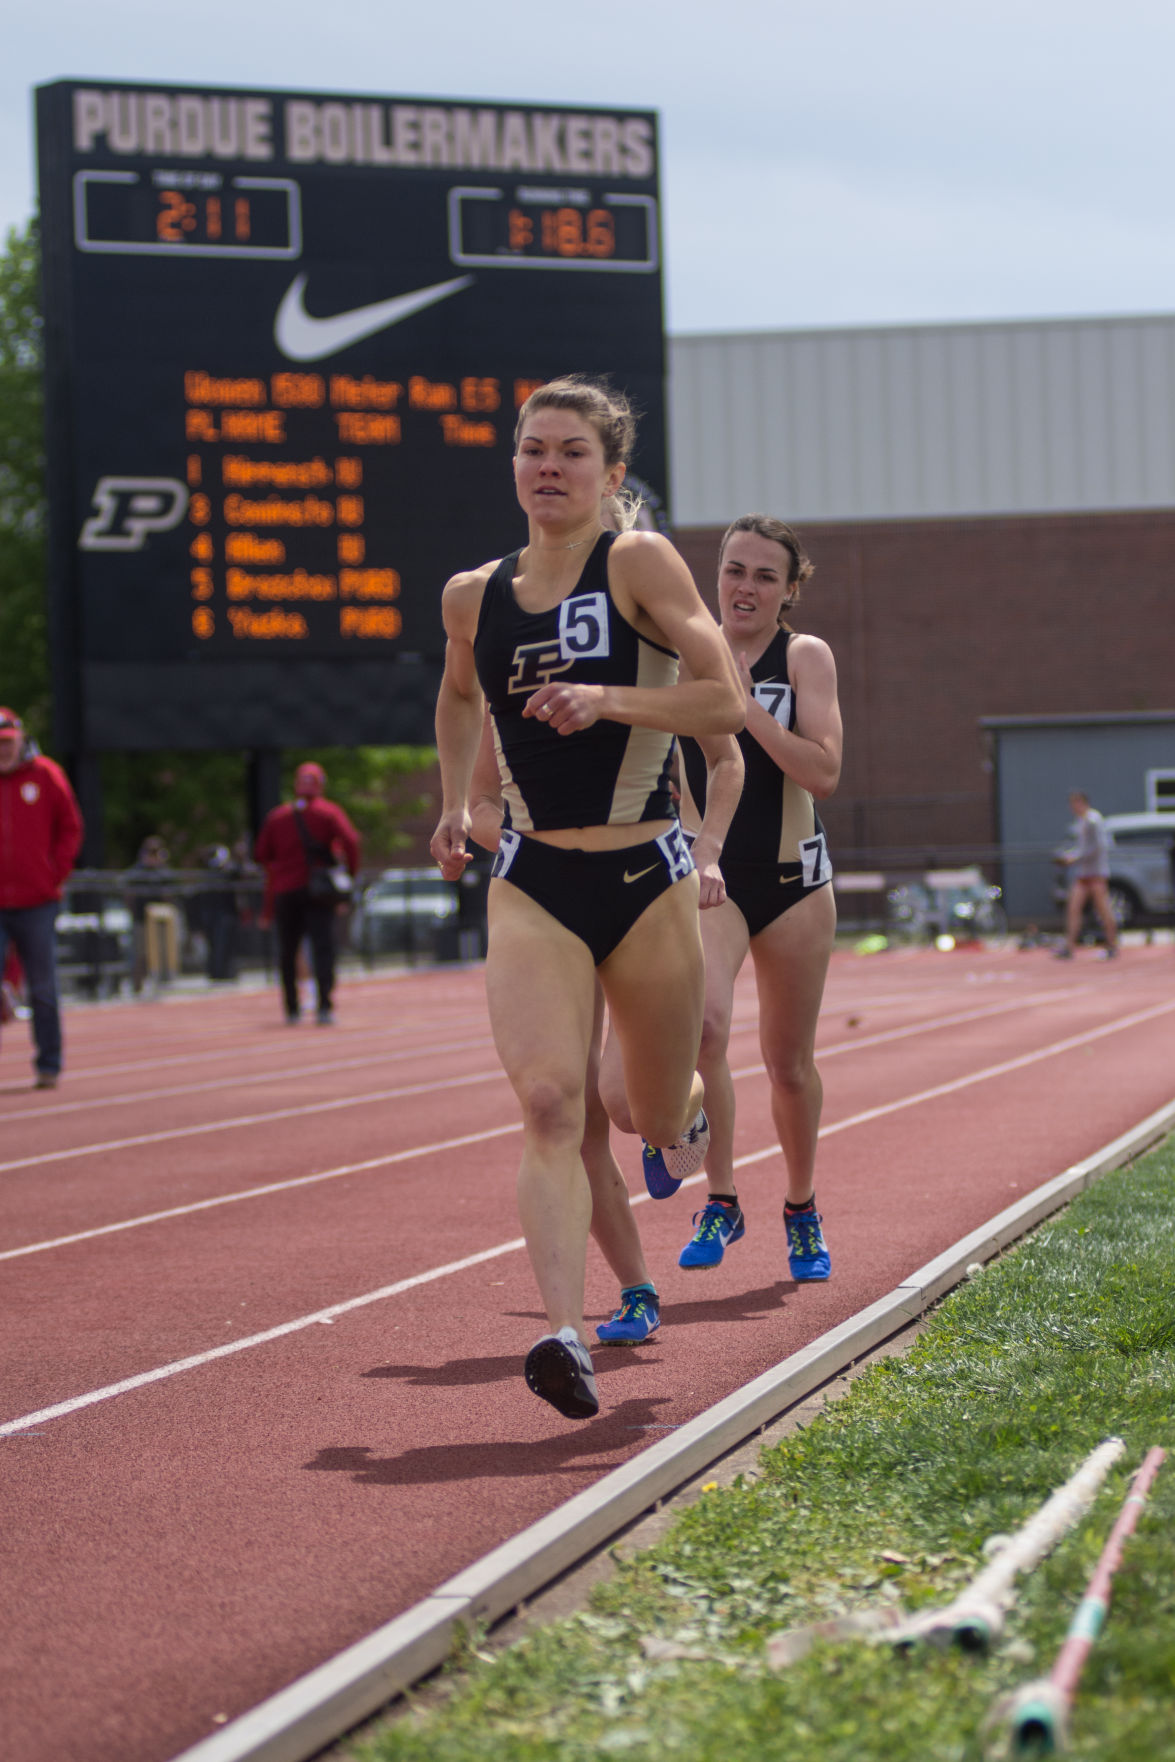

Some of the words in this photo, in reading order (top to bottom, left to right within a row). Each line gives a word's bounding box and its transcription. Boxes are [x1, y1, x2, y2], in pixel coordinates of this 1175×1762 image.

[73, 89, 275, 164] PURDUE
[285, 100, 655, 179] BOILERMAKERS
[157, 190, 251, 241] 2:11
[566, 597, 600, 652] 5
[760, 687, 786, 717] 7
[803, 838, 822, 882] 7
